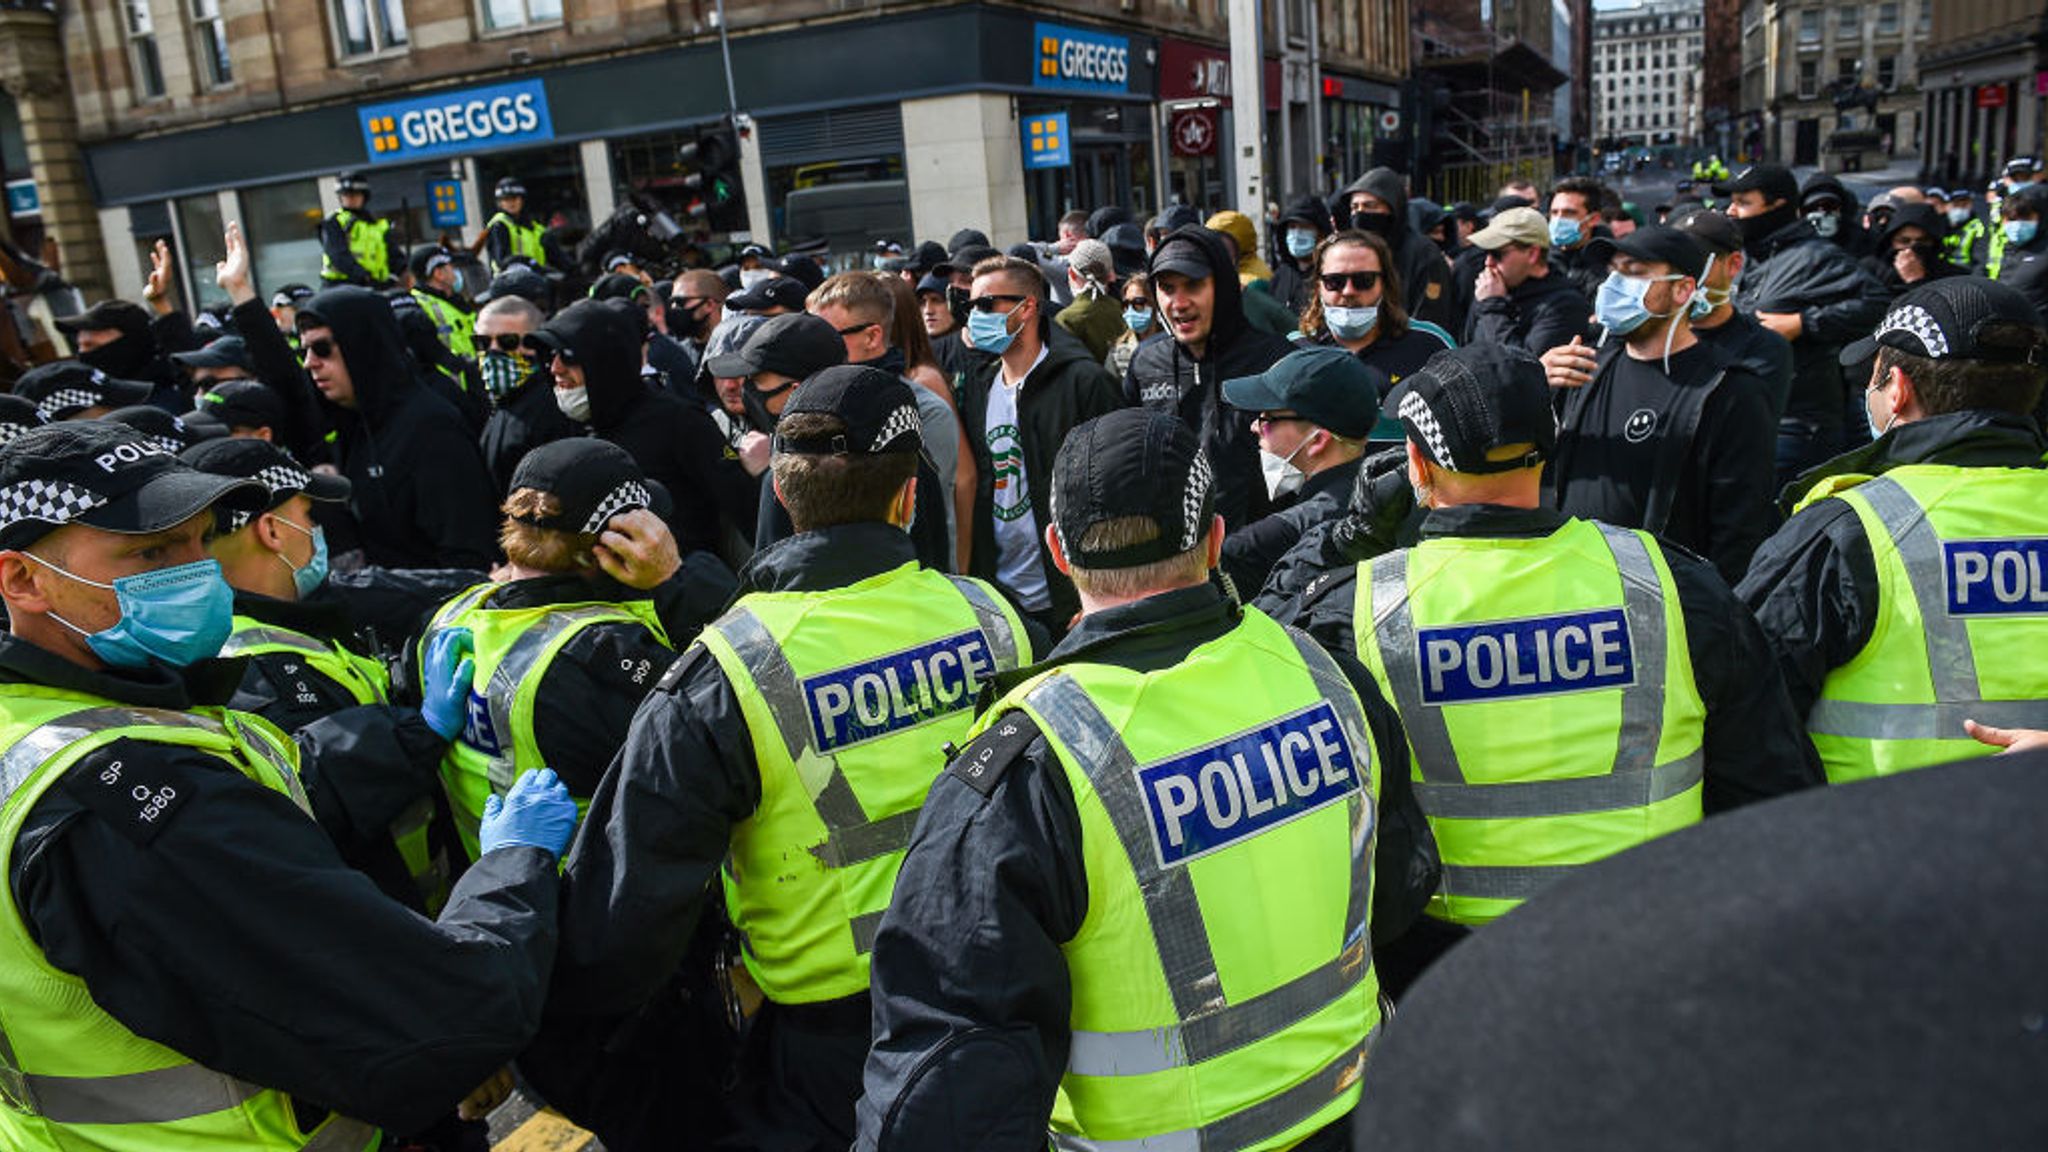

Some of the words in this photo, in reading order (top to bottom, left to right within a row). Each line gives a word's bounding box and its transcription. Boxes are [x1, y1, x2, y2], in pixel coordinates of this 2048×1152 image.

[1061, 38, 1127, 82] GREGGS
[401, 93, 538, 147] GREGGS
[1427, 620, 1625, 693] POLICE
[813, 640, 988, 739] POLICE
[100, 761, 122, 785] SP
[132, 785, 152, 801] Q
[1153, 718, 1350, 847] POLICE
[139, 786, 176, 823] 1580
